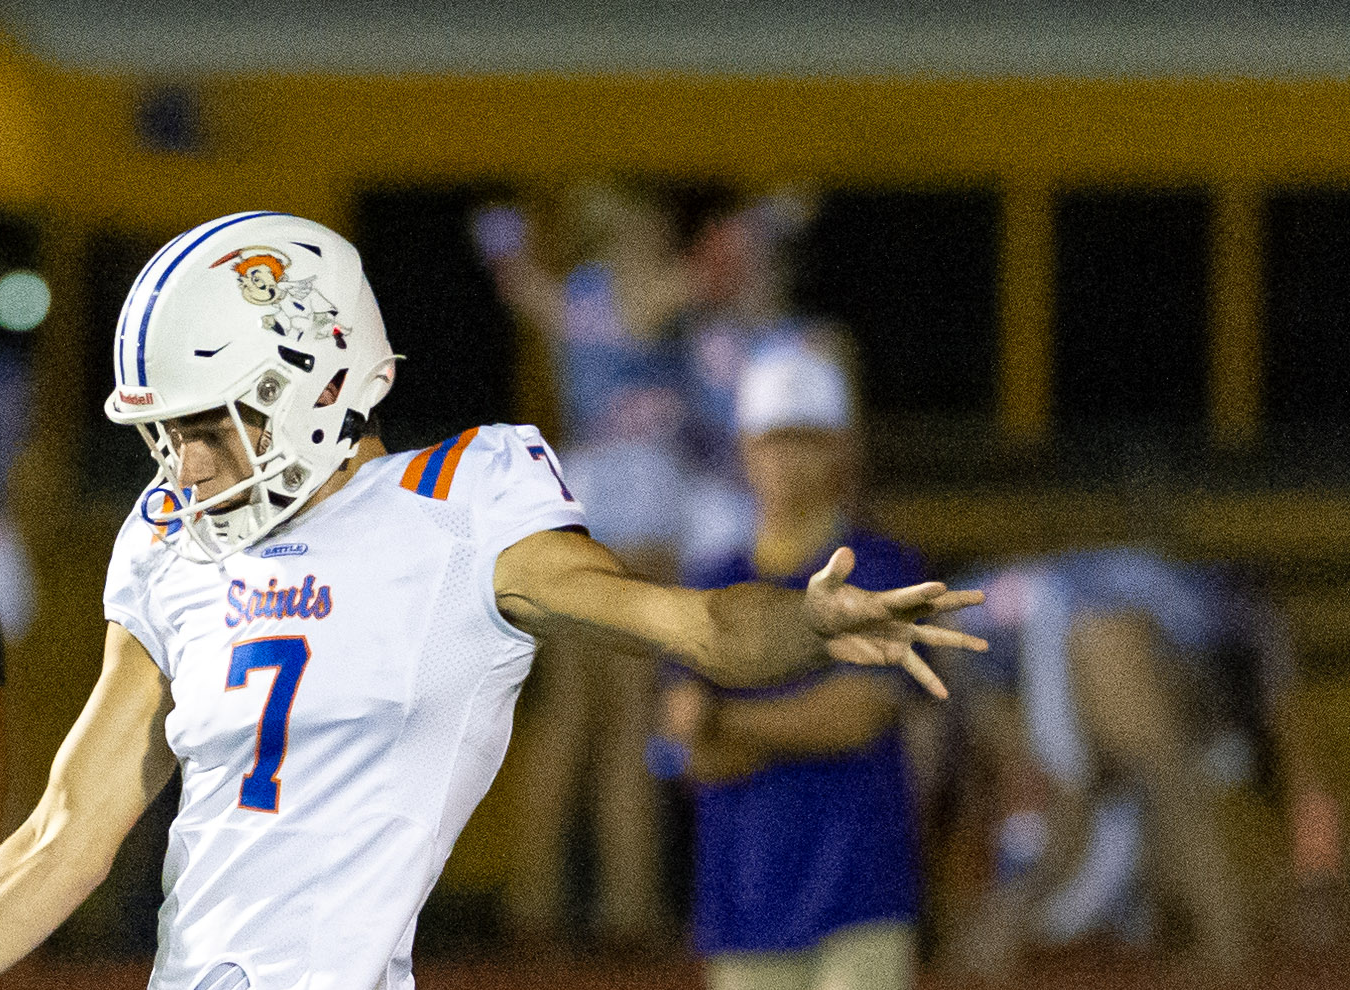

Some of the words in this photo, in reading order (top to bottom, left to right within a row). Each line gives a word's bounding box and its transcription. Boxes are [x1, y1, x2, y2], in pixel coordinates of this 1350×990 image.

[526, 445, 575, 502] 7
[264, 545, 304, 556] BATTLE
[225, 574, 333, 628] Saints
[225, 635, 312, 814] 7
